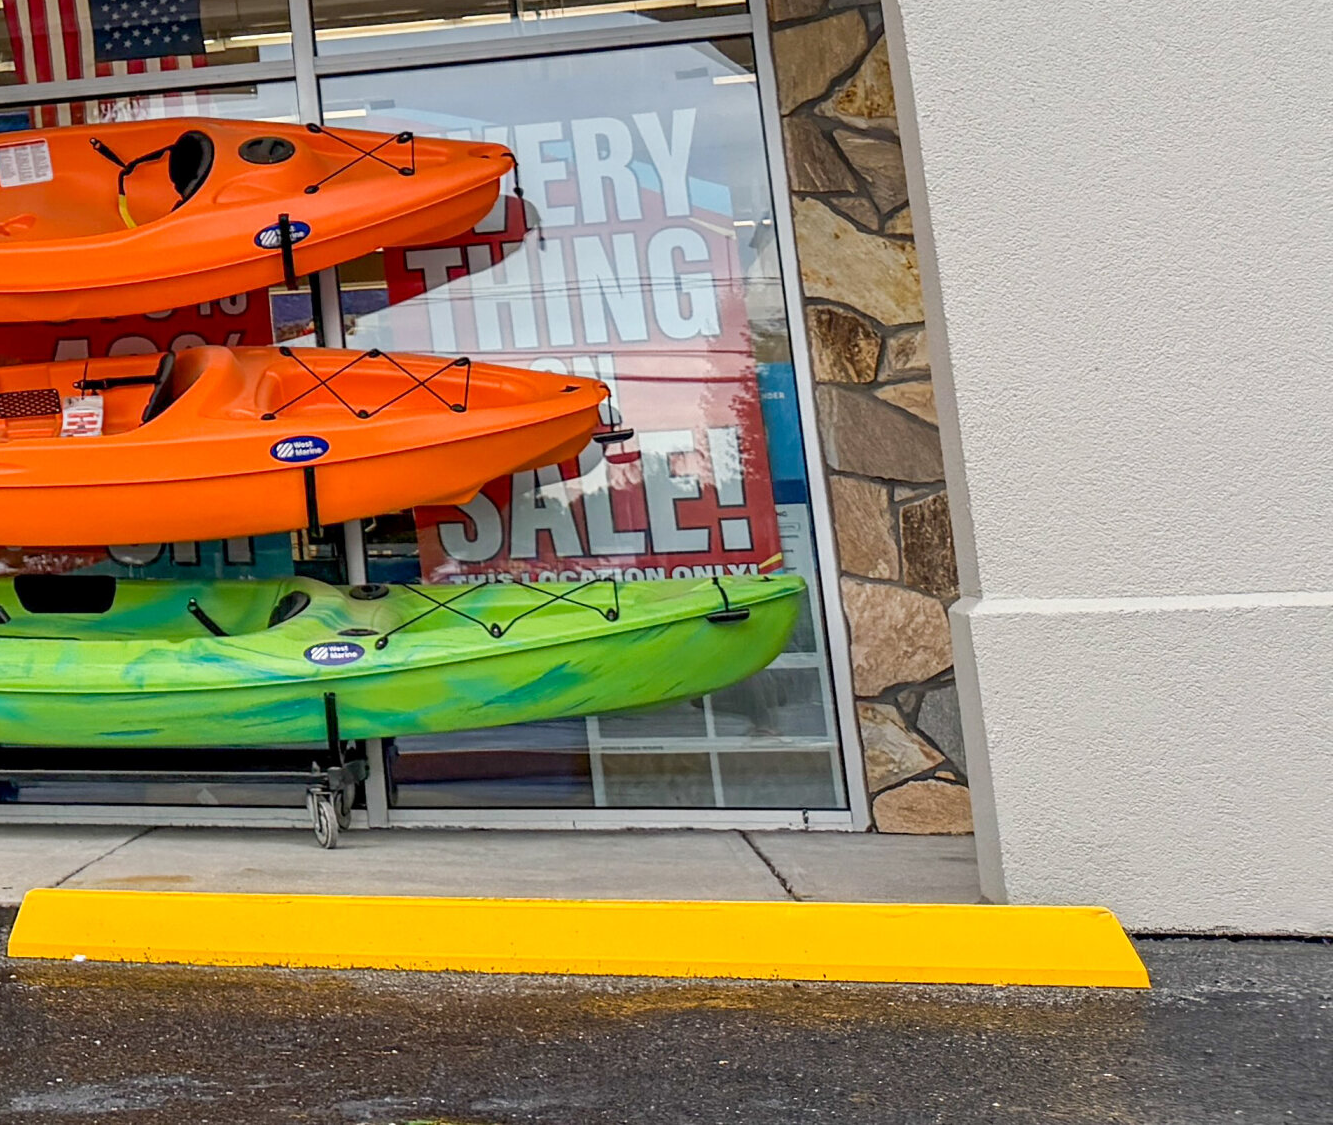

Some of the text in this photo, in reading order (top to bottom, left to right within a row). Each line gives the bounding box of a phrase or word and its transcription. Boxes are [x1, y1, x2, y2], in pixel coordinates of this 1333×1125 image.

[413, 107, 697, 234] ERY
[405, 226, 721, 352] THING
[293, 441, 323, 457] West Marine
[437, 427, 753, 565] SALE!
[328, 645, 349, 653] West
